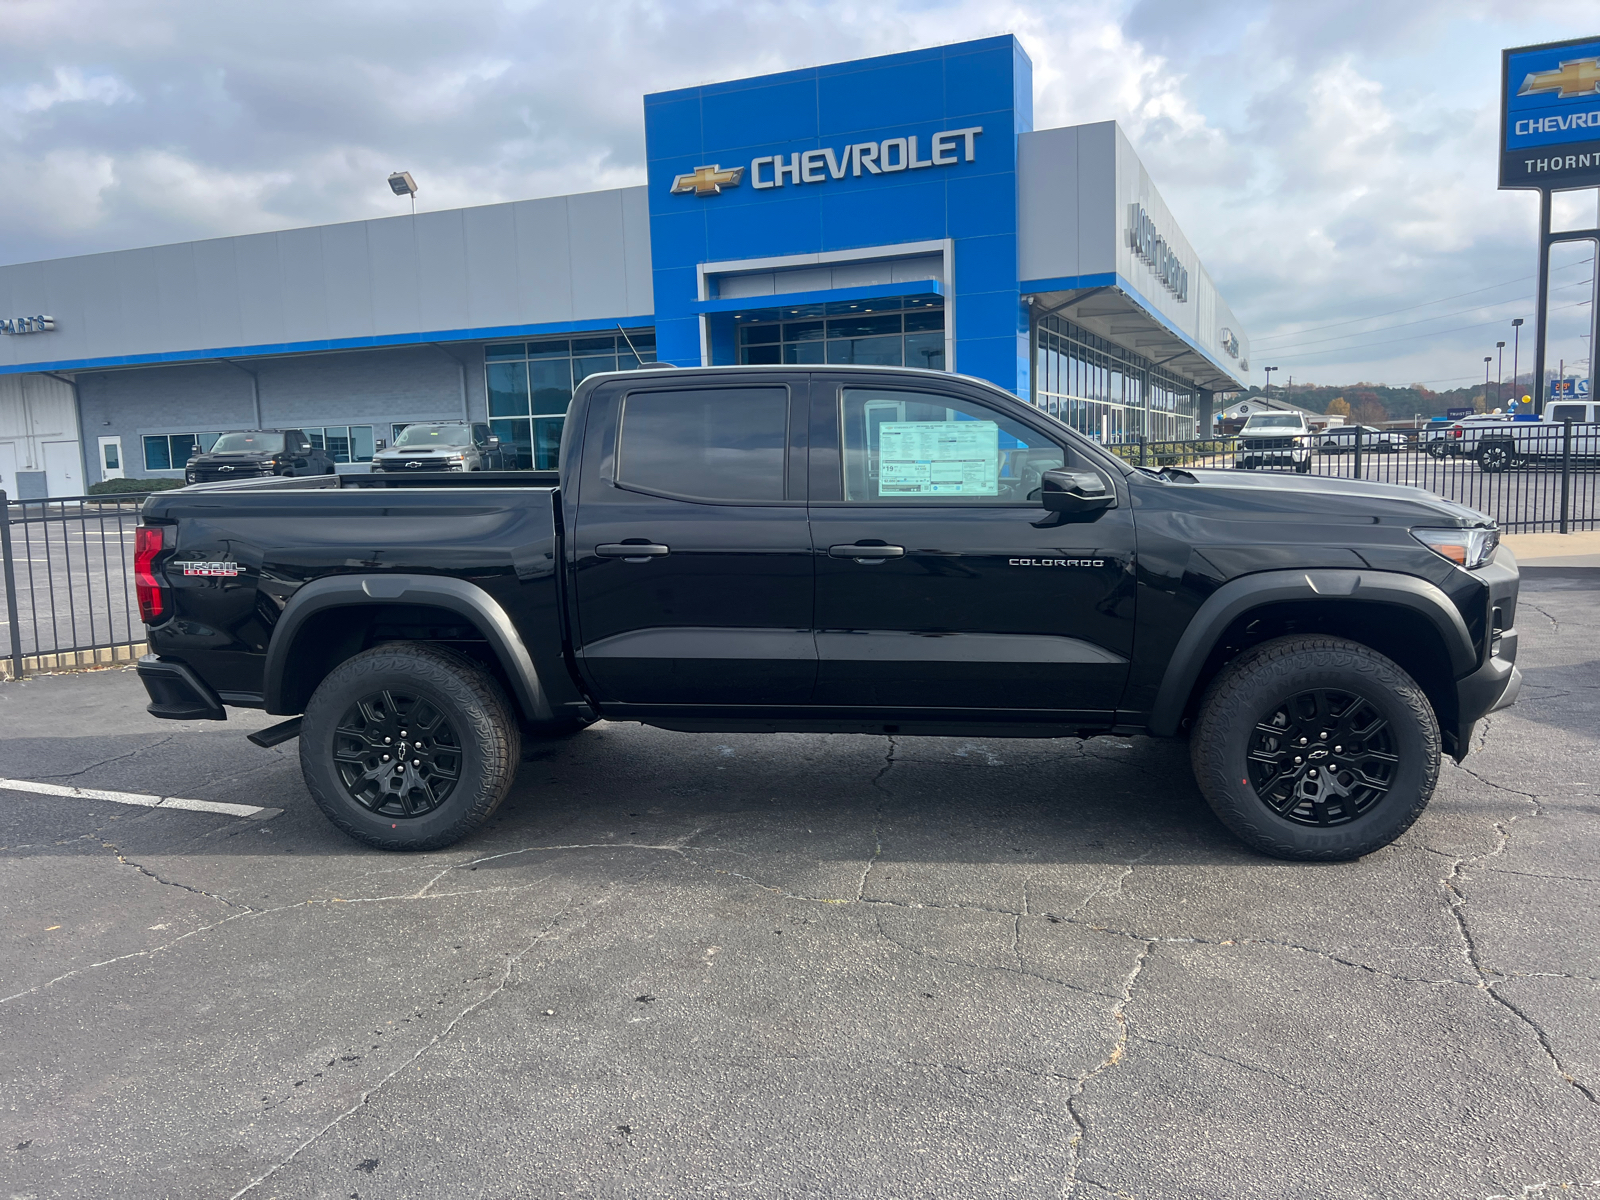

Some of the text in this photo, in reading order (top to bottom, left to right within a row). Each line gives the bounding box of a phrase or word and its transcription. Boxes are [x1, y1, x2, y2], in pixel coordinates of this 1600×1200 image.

[1515, 111, 1600, 136] CHEVRO
[751, 126, 984, 190] CHEVROLET
[1525, 152, 1600, 173] THORNT
[0, 314, 52, 335] PARTS
[174, 561, 247, 571] TRAIL
[184, 569, 238, 577] BOSS
[1008, 558, 1105, 567] COLORADO
